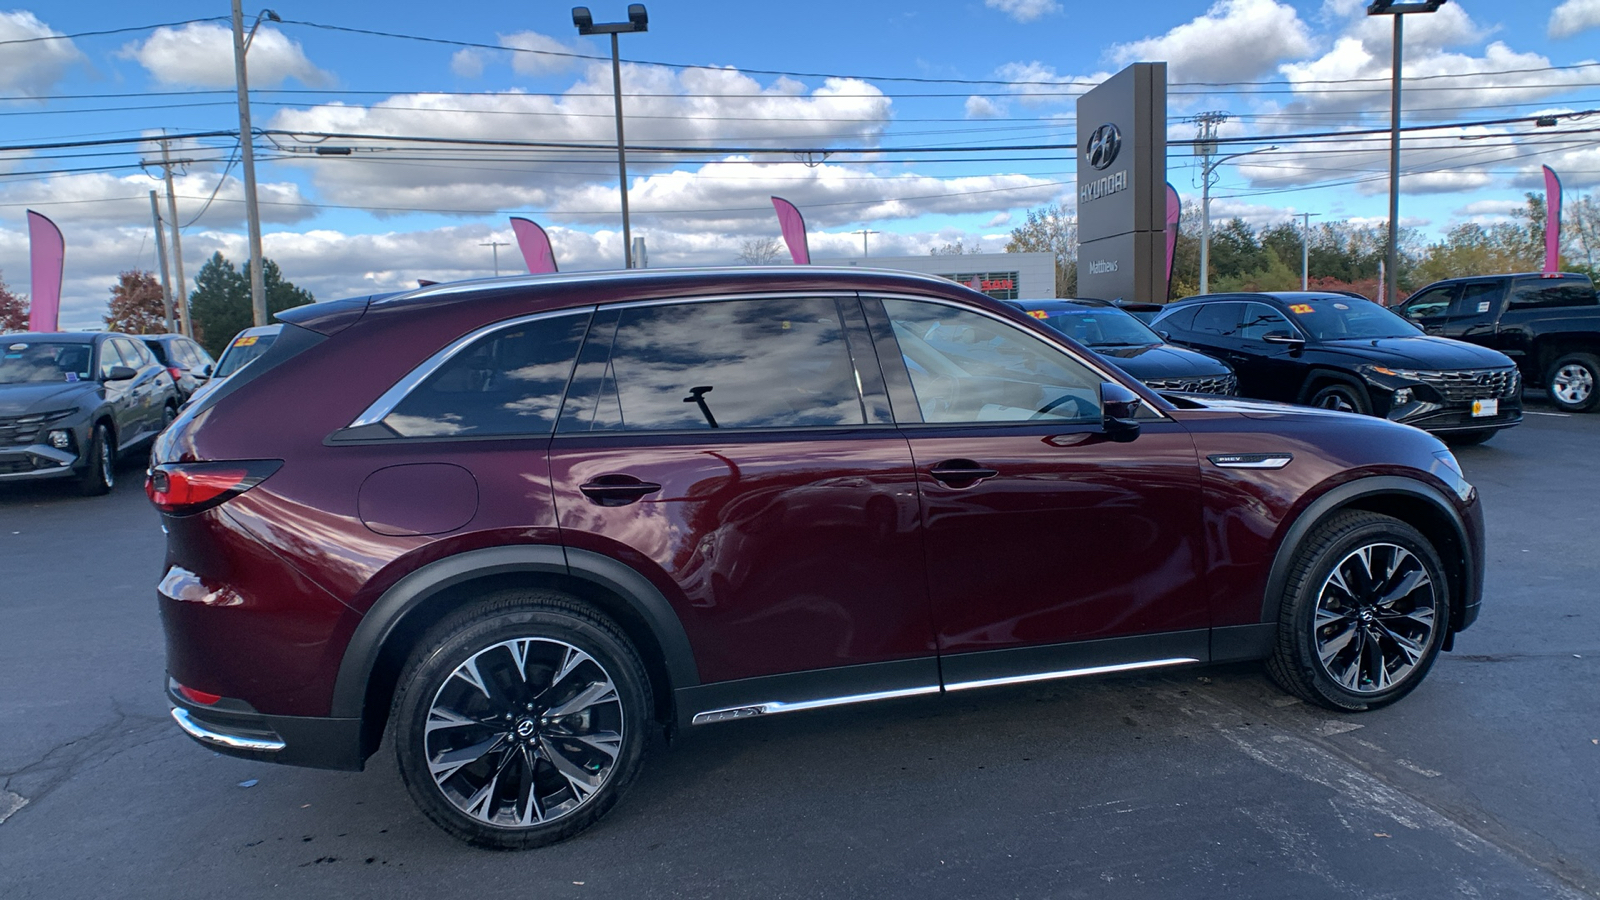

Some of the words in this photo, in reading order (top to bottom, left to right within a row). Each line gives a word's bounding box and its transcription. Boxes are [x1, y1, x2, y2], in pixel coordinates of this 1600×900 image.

[1081, 170, 1128, 204] HYUNDAI
[1089, 260, 1118, 274] Matthews
[1289, 304, 1313, 314] 22
